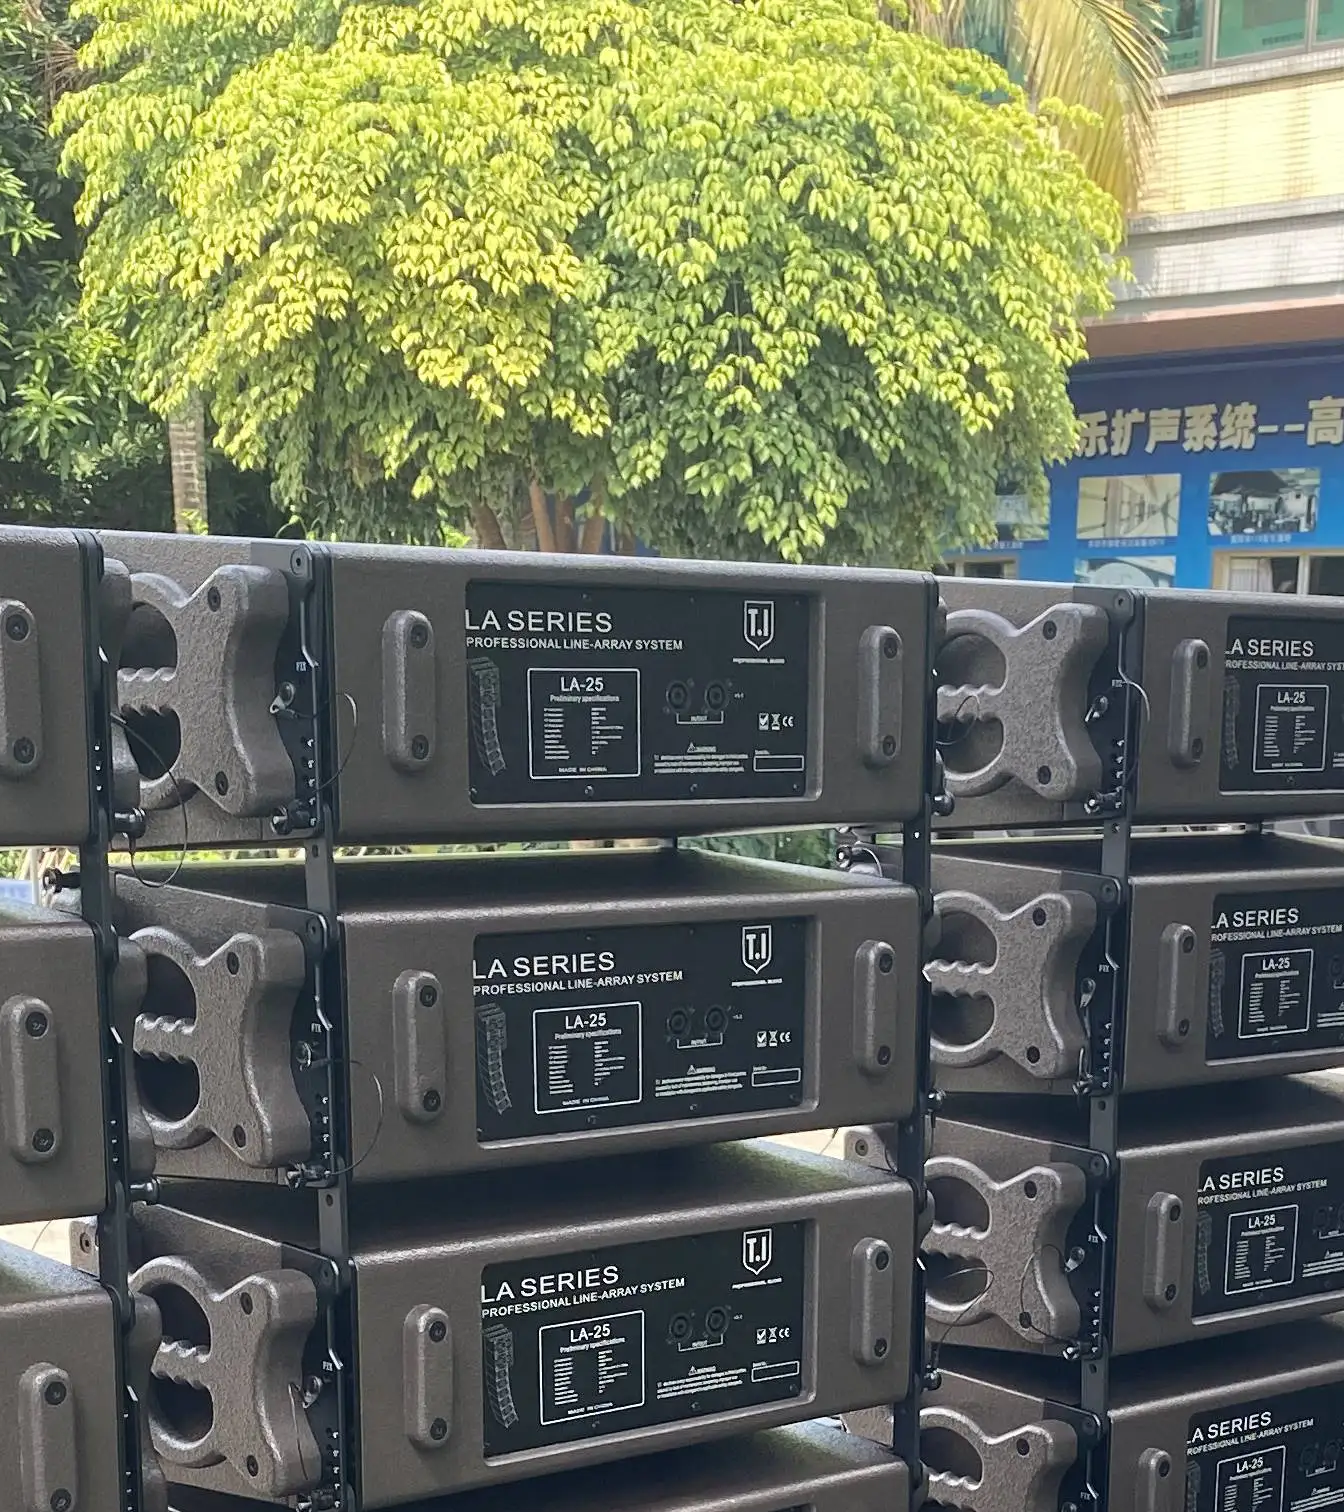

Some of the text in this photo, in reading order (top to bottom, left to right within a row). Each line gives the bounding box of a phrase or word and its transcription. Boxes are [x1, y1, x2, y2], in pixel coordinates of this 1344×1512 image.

[464, 607, 613, 634] LA SERIES
[465, 635, 683, 652] PROFESSIONAL LINE-ARRAY SYSTEM
[1246, 638, 1314, 658] SERIES
[560, 676, 604, 693] LA-25
[1277, 690, 1306, 704] LA-25
[1232, 907, 1299, 928] SERIES
[472, 951, 615, 980] LA SERIES
[1262, 956, 1291, 971] LA-25
[473, 970, 683, 997] PROFESSIONAL LINE-ARRAY SYSTEM
[564, 1012, 607, 1031] LA-25
[1218, 1166, 1284, 1191] SERIES
[1247, 1213, 1276, 1230] LA-25
[480, 1265, 619, 1304] LA SERIES
[481, 1277, 685, 1319] PROFESSIONAL LINE-ARRAY SYSTEM
[569, 1323, 611, 1344] LA-25
[1207, 1410, 1272, 1439] SERIES
[1236, 1456, 1264, 1474] LA-25
